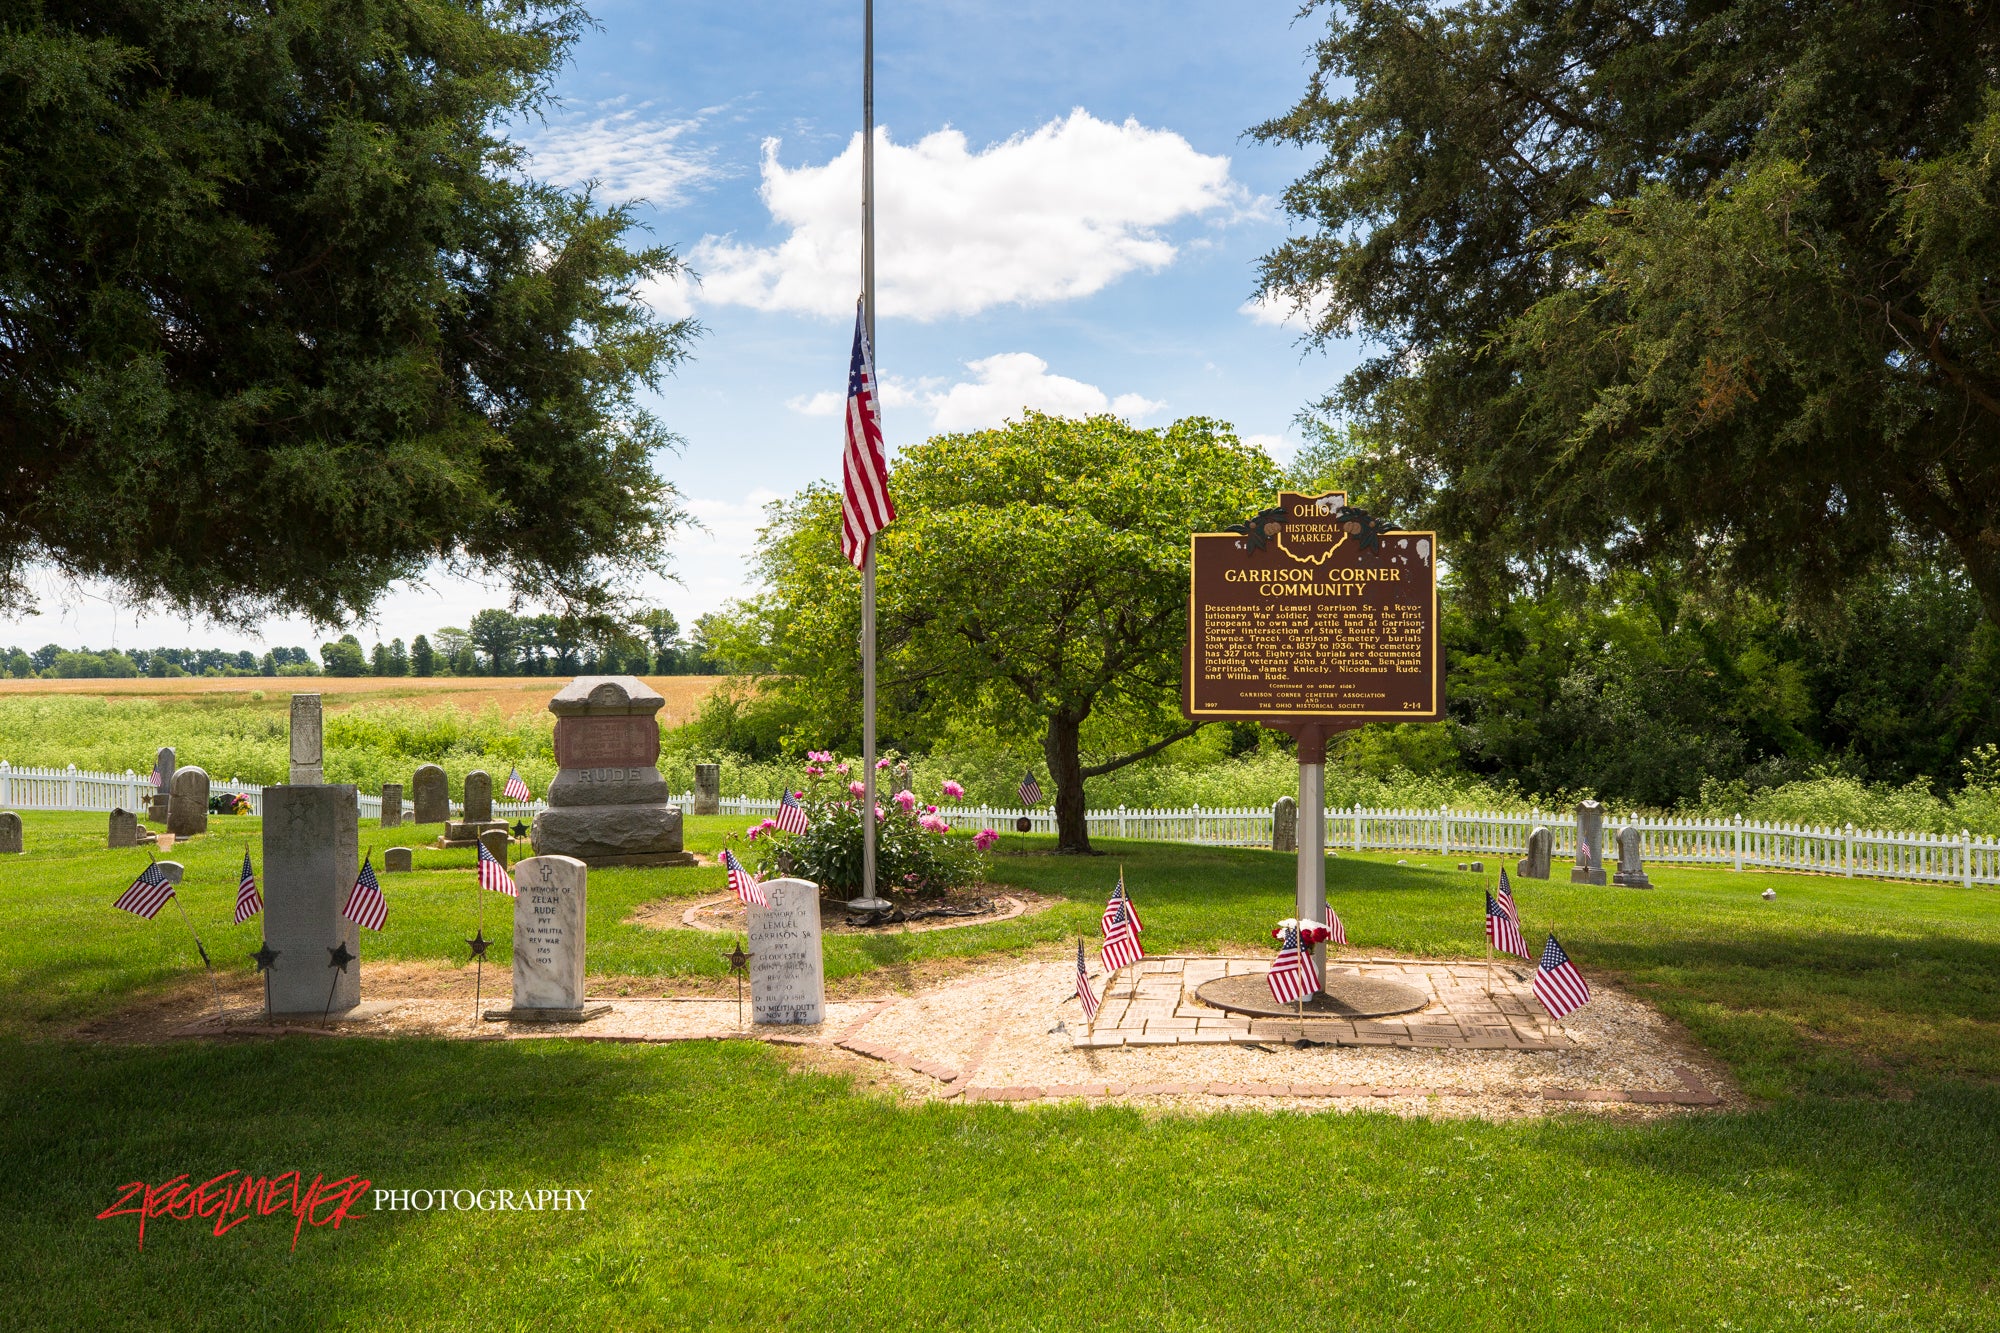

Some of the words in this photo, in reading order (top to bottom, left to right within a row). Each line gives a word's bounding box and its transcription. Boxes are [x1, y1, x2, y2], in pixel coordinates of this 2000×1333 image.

[1293, 505, 1329, 517] OHIO
[1285, 524, 1340, 533] HISTORICAL
[1291, 533, 1332, 542] MARKER
[1224, 569, 1314, 582] GARRISON
[1329, 568, 1400, 581] CORNER
[1260, 583, 1366, 596] COMMUNITY
[1266, 650, 1311, 658] Eighty-six
[1205, 658, 1245, 666] including
[602, 687, 617, 705] R
[578, 768, 641, 782] RUDE
[764, 921, 798, 929] LEMUEL
[751, 932, 798, 940] GARRISON
